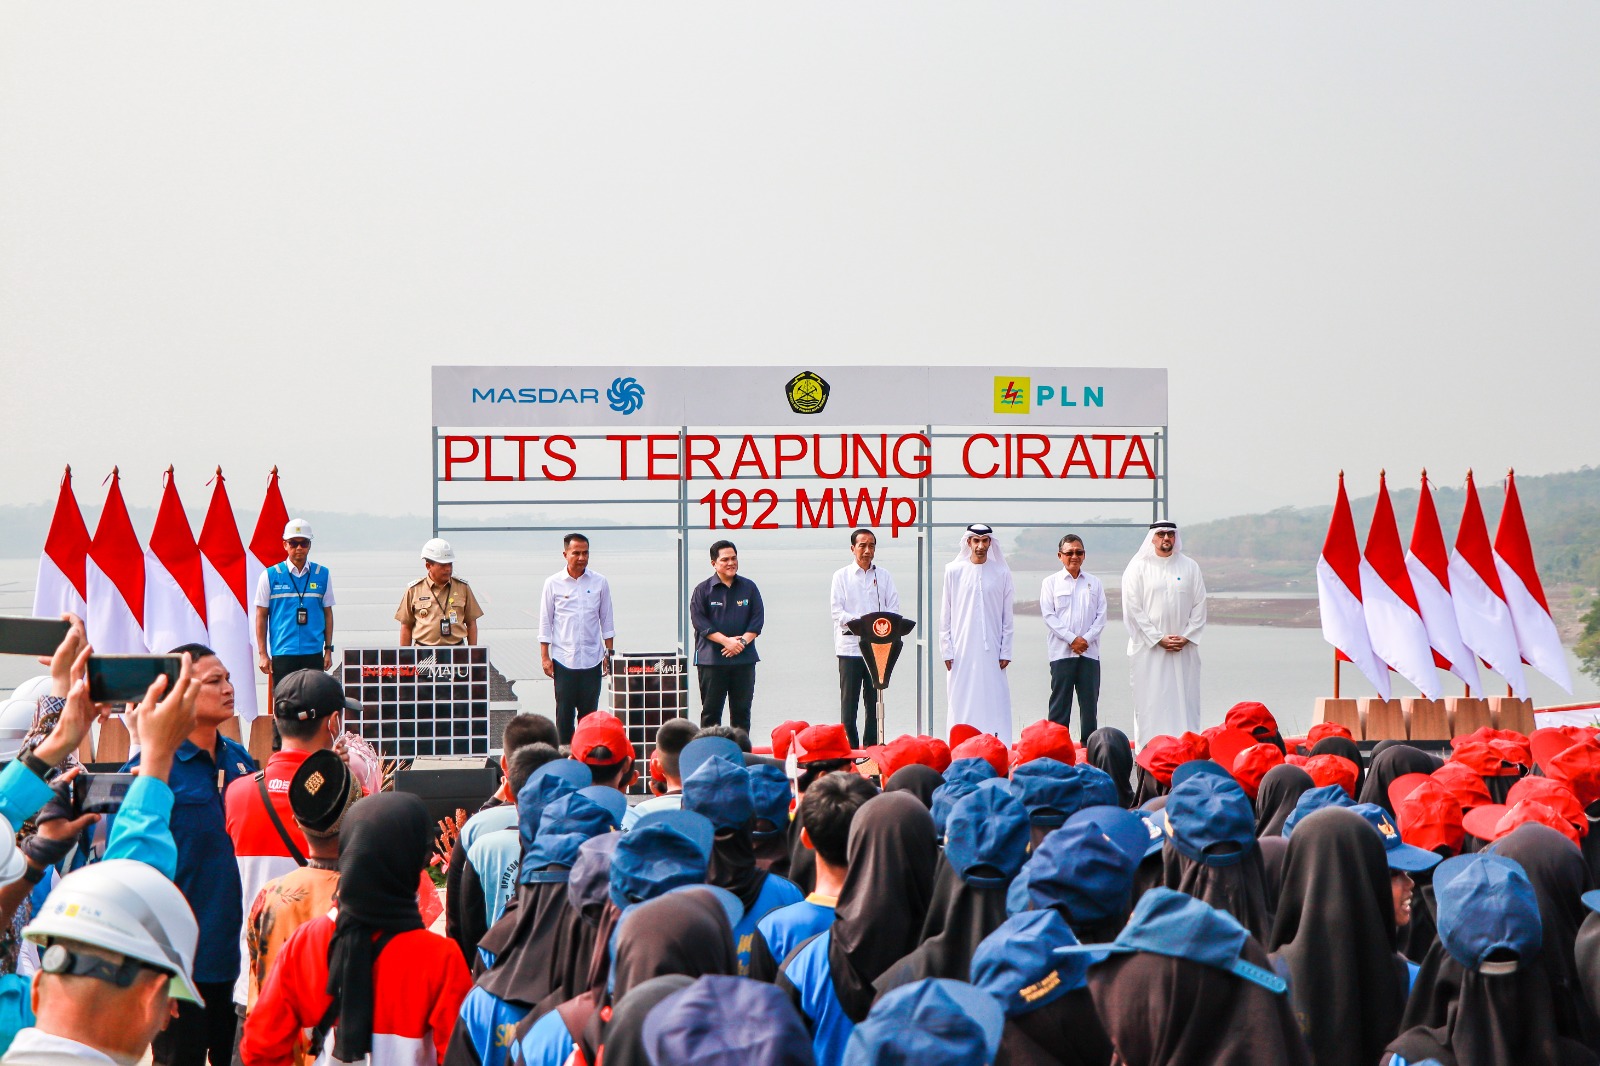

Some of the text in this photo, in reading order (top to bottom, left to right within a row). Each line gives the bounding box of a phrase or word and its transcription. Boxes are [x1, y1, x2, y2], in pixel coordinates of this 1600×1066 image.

[472, 387, 599, 404] MASDAR
[1036, 385, 1104, 408] PLN
[444, 433, 1157, 481] PLTS TERAPUNG CIRATA
[699, 486, 917, 538] 192 MWp
[427, 665, 470, 681] MAJU
